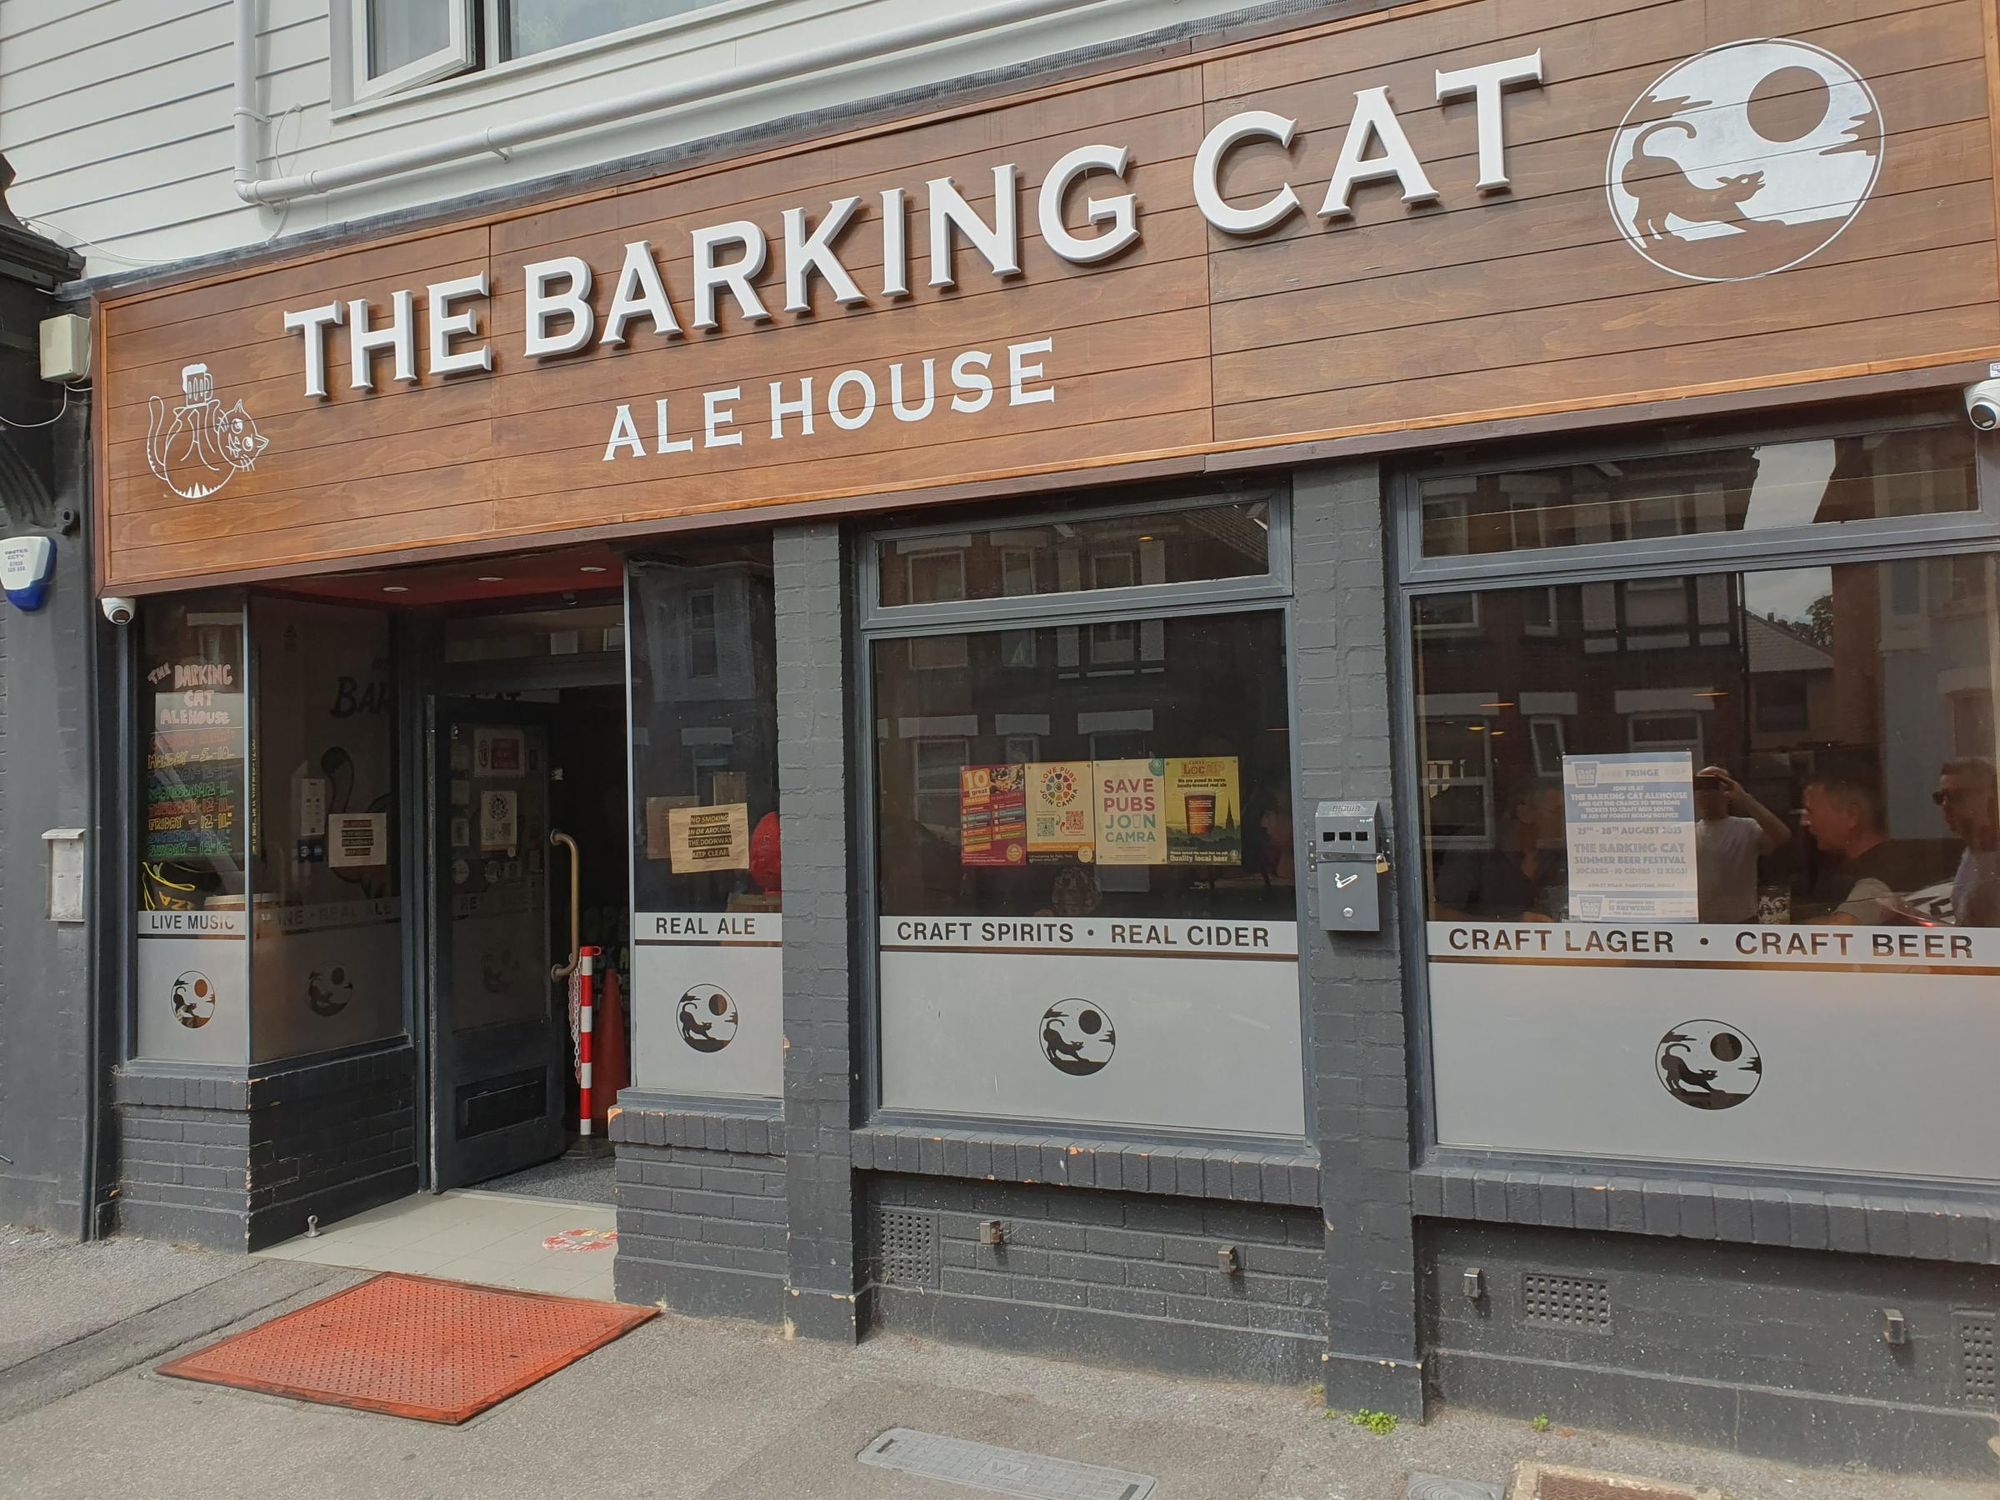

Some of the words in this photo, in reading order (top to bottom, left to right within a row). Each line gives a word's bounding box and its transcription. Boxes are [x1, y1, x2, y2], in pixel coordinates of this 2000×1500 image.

[284, 270, 493, 398] THE
[522, 144, 1141, 360] BARKING
[1192, 47, 1545, 236] CAT
[146, 662, 172, 685] THE
[174, 663, 233, 689] BARKING
[184, 690, 215, 708] CAT
[160, 709, 232, 725] ALEHOUSE
[963, 769, 989, 789] 10
[1041, 766, 1057, 783] LOVE
[1060, 766, 1077, 782] PUBS
[1625, 769, 1660, 777] FRINGE
[971, 787, 988, 796] great
[1104, 778, 1154, 794] SAVE
[1040, 789, 1053, 806] JOIN
[1056, 788, 1079, 807] CAMRA
[1587, 792, 1625, 800] BARKING
[1104, 797, 1155, 812] PUBS
[149, 815, 184, 831] FRIDAY
[1105, 831, 1156, 843] CAMRA
[1574, 843, 1597, 853] THE
[1598, 843, 1657, 853] BARKING
[1660, 842, 1685, 853] CAT
[1169, 855, 1192, 863] Quality
[1194, 854, 1212, 862] local
[1574, 856, 1615, 864] SUMMER
[1617, 856, 1641, 864] BEER
[1643, 856, 1687, 864] FESTIVAL
[151, 915, 182, 929] LIVE
[187, 914, 234, 930] MUSIC
[656, 917, 708, 934] REAL
[717, 918, 756, 935] ALE
[897, 922, 972, 942] CRAFT
[981, 923, 1074, 943] SPIRITS
[1111, 924, 1178, 945] REAL
[1186, 925, 1270, 948] CIDER
[1448, 927, 1552, 952] CRAFT
[1564, 929, 1675, 954] LAGER
[1735, 931, 1853, 957] CRAFT
[1872, 933, 1974, 960] BEER
